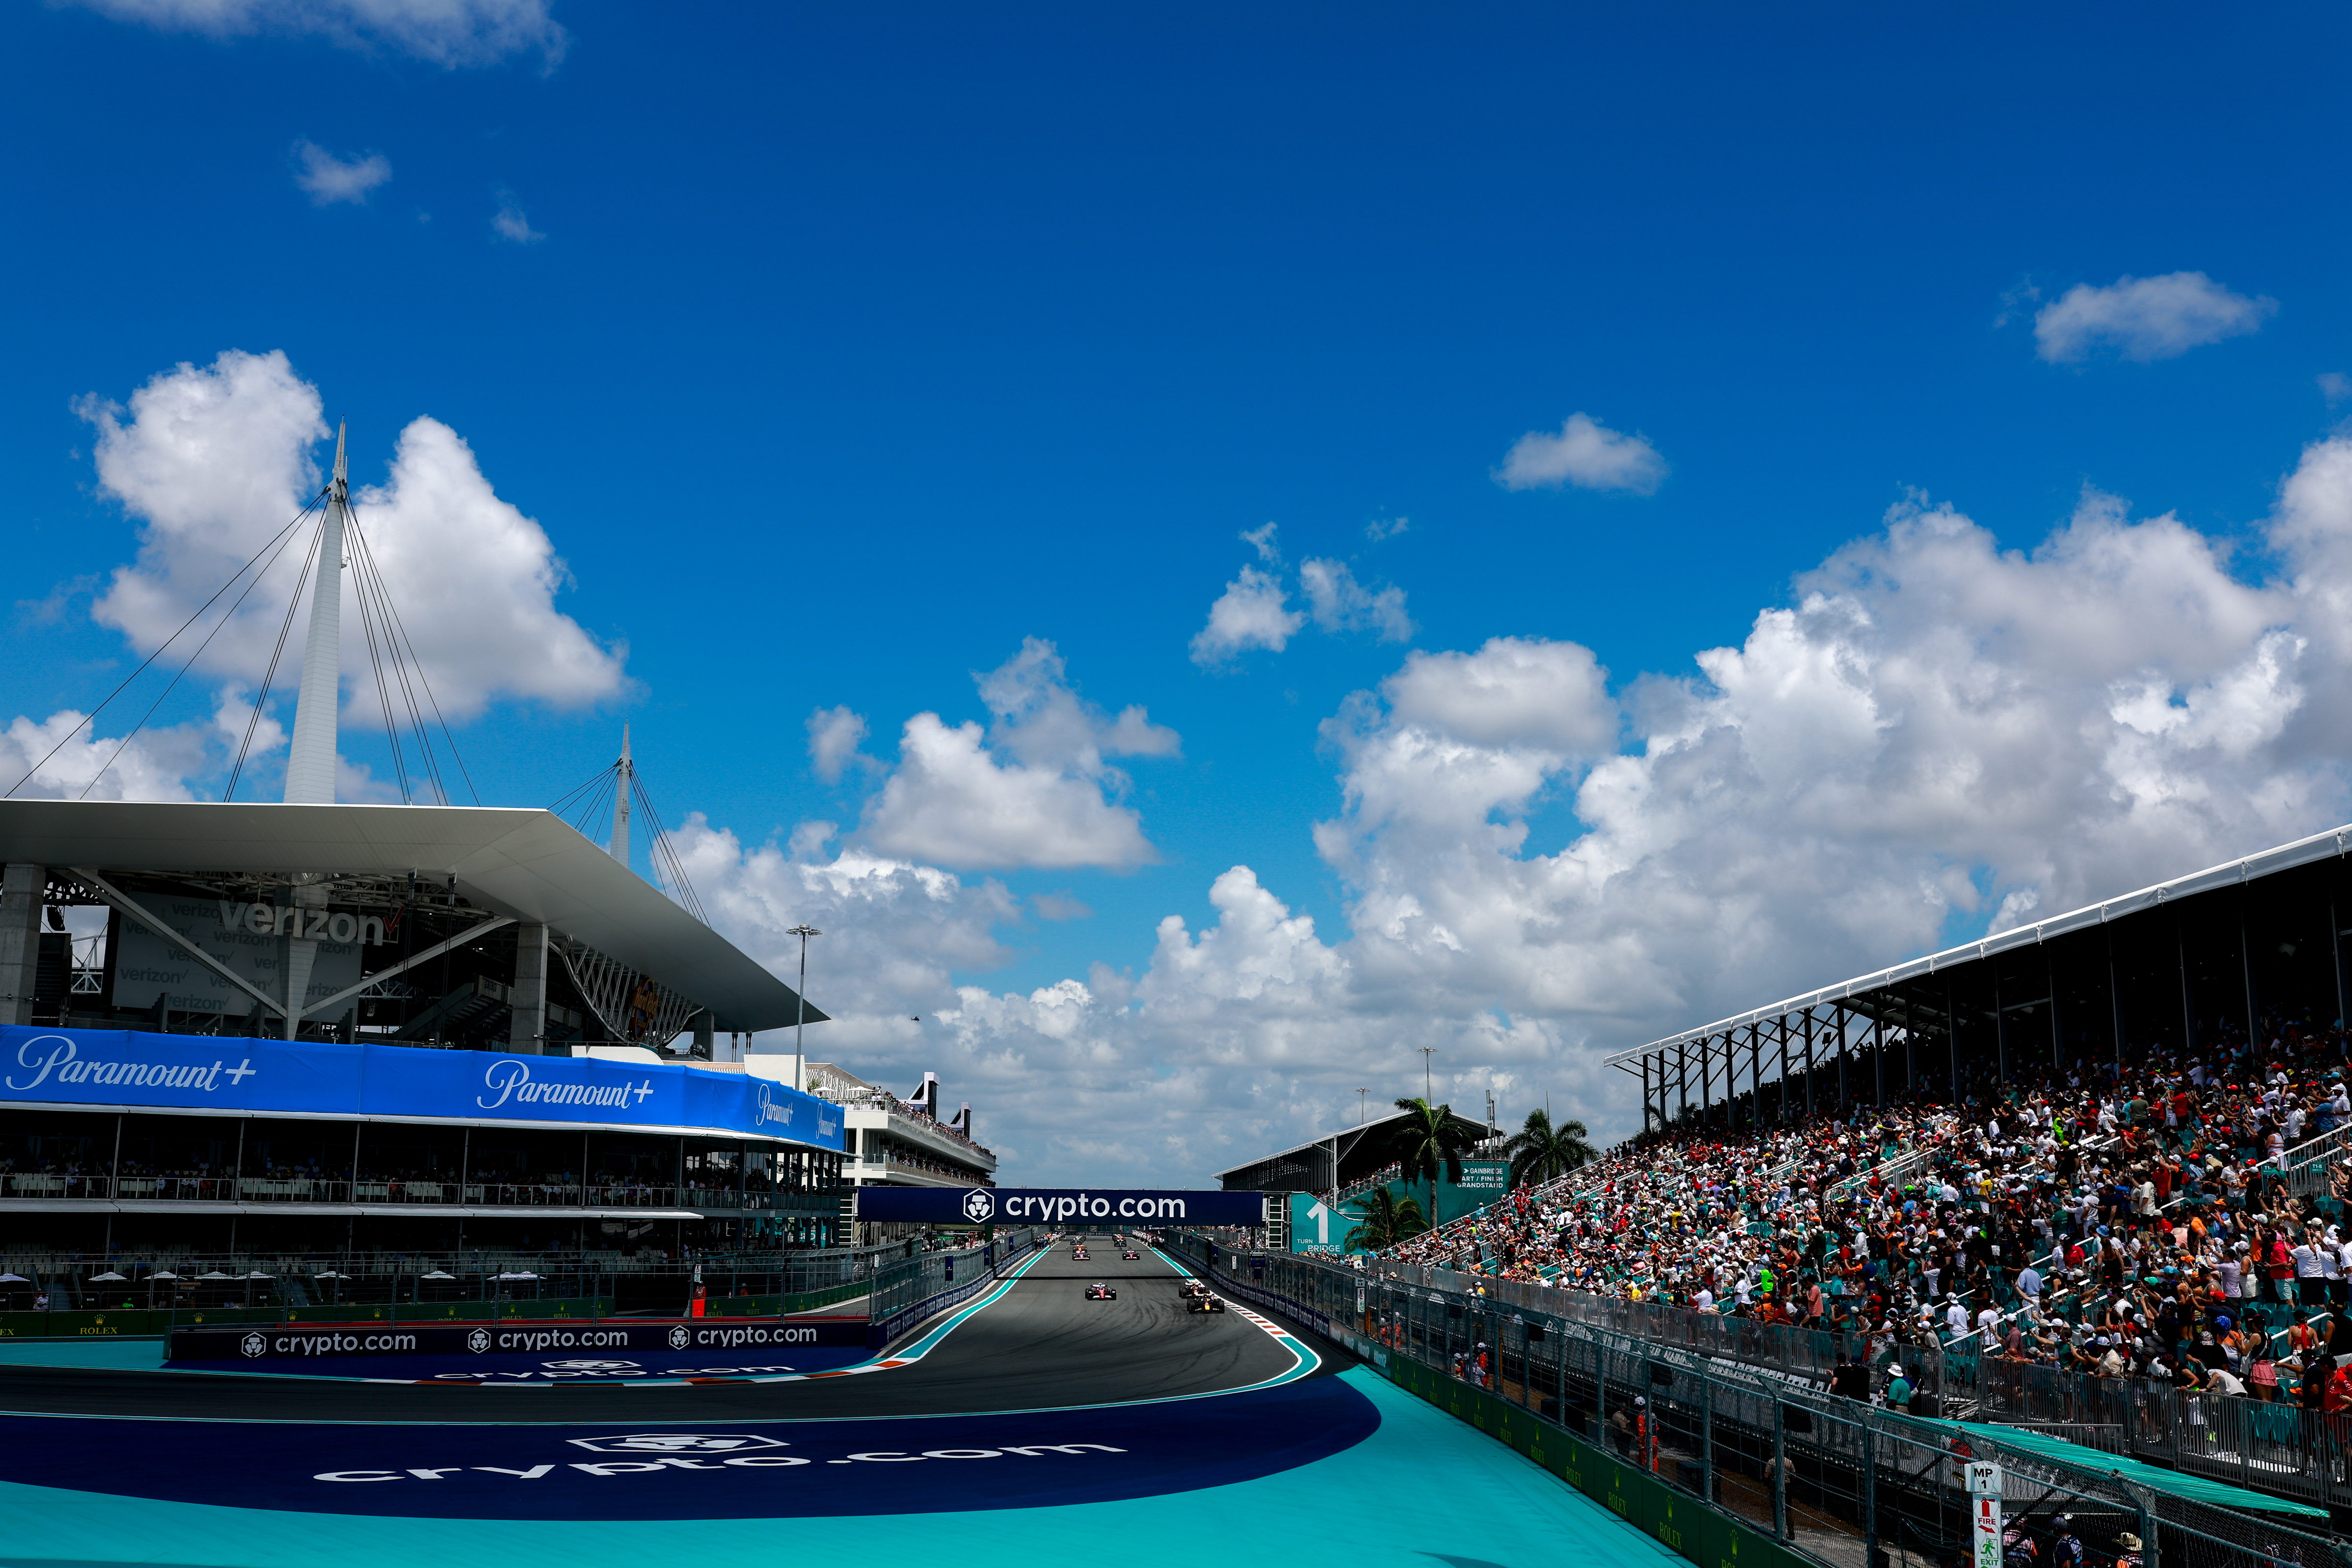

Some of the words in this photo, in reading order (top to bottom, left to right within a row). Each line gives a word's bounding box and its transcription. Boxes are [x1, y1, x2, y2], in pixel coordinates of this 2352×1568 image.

[172, 903, 221, 919] verizo
[219, 899, 384, 946] verizon
[214, 931, 270, 947] verizon
[120, 968, 180, 983] verizon
[6, 1035, 256, 1091] Paramount+
[477, 1060, 654, 1109] Paramount+
[756, 1083, 793, 1127] Paramount+
[1005, 1194, 1186, 1222] crypto.com
[1306, 1200, 1328, 1244] 1
[275, 1333, 416, 1355] crypto.com
[499, 1329, 628, 1350] crypto.com
[697, 1326, 817, 1347] crypto.com
[434, 1365, 795, 1379] crypto.com
[1474, 1414, 1484, 1428] ROLEX
[1500, 1427, 1512, 1444] ROLEX
[314, 1442, 1128, 1482] crypto.com
[1531, 1445, 1544, 1464] ROLEX
[1566, 1467, 1581, 1487] ROLEX
[1974, 1468, 1993, 1477] MP
[1981, 1480, 1986, 1489] 1
[1608, 1492, 1627, 1516] ROLEX
[1659, 1521, 1682, 1550] ROLEX
